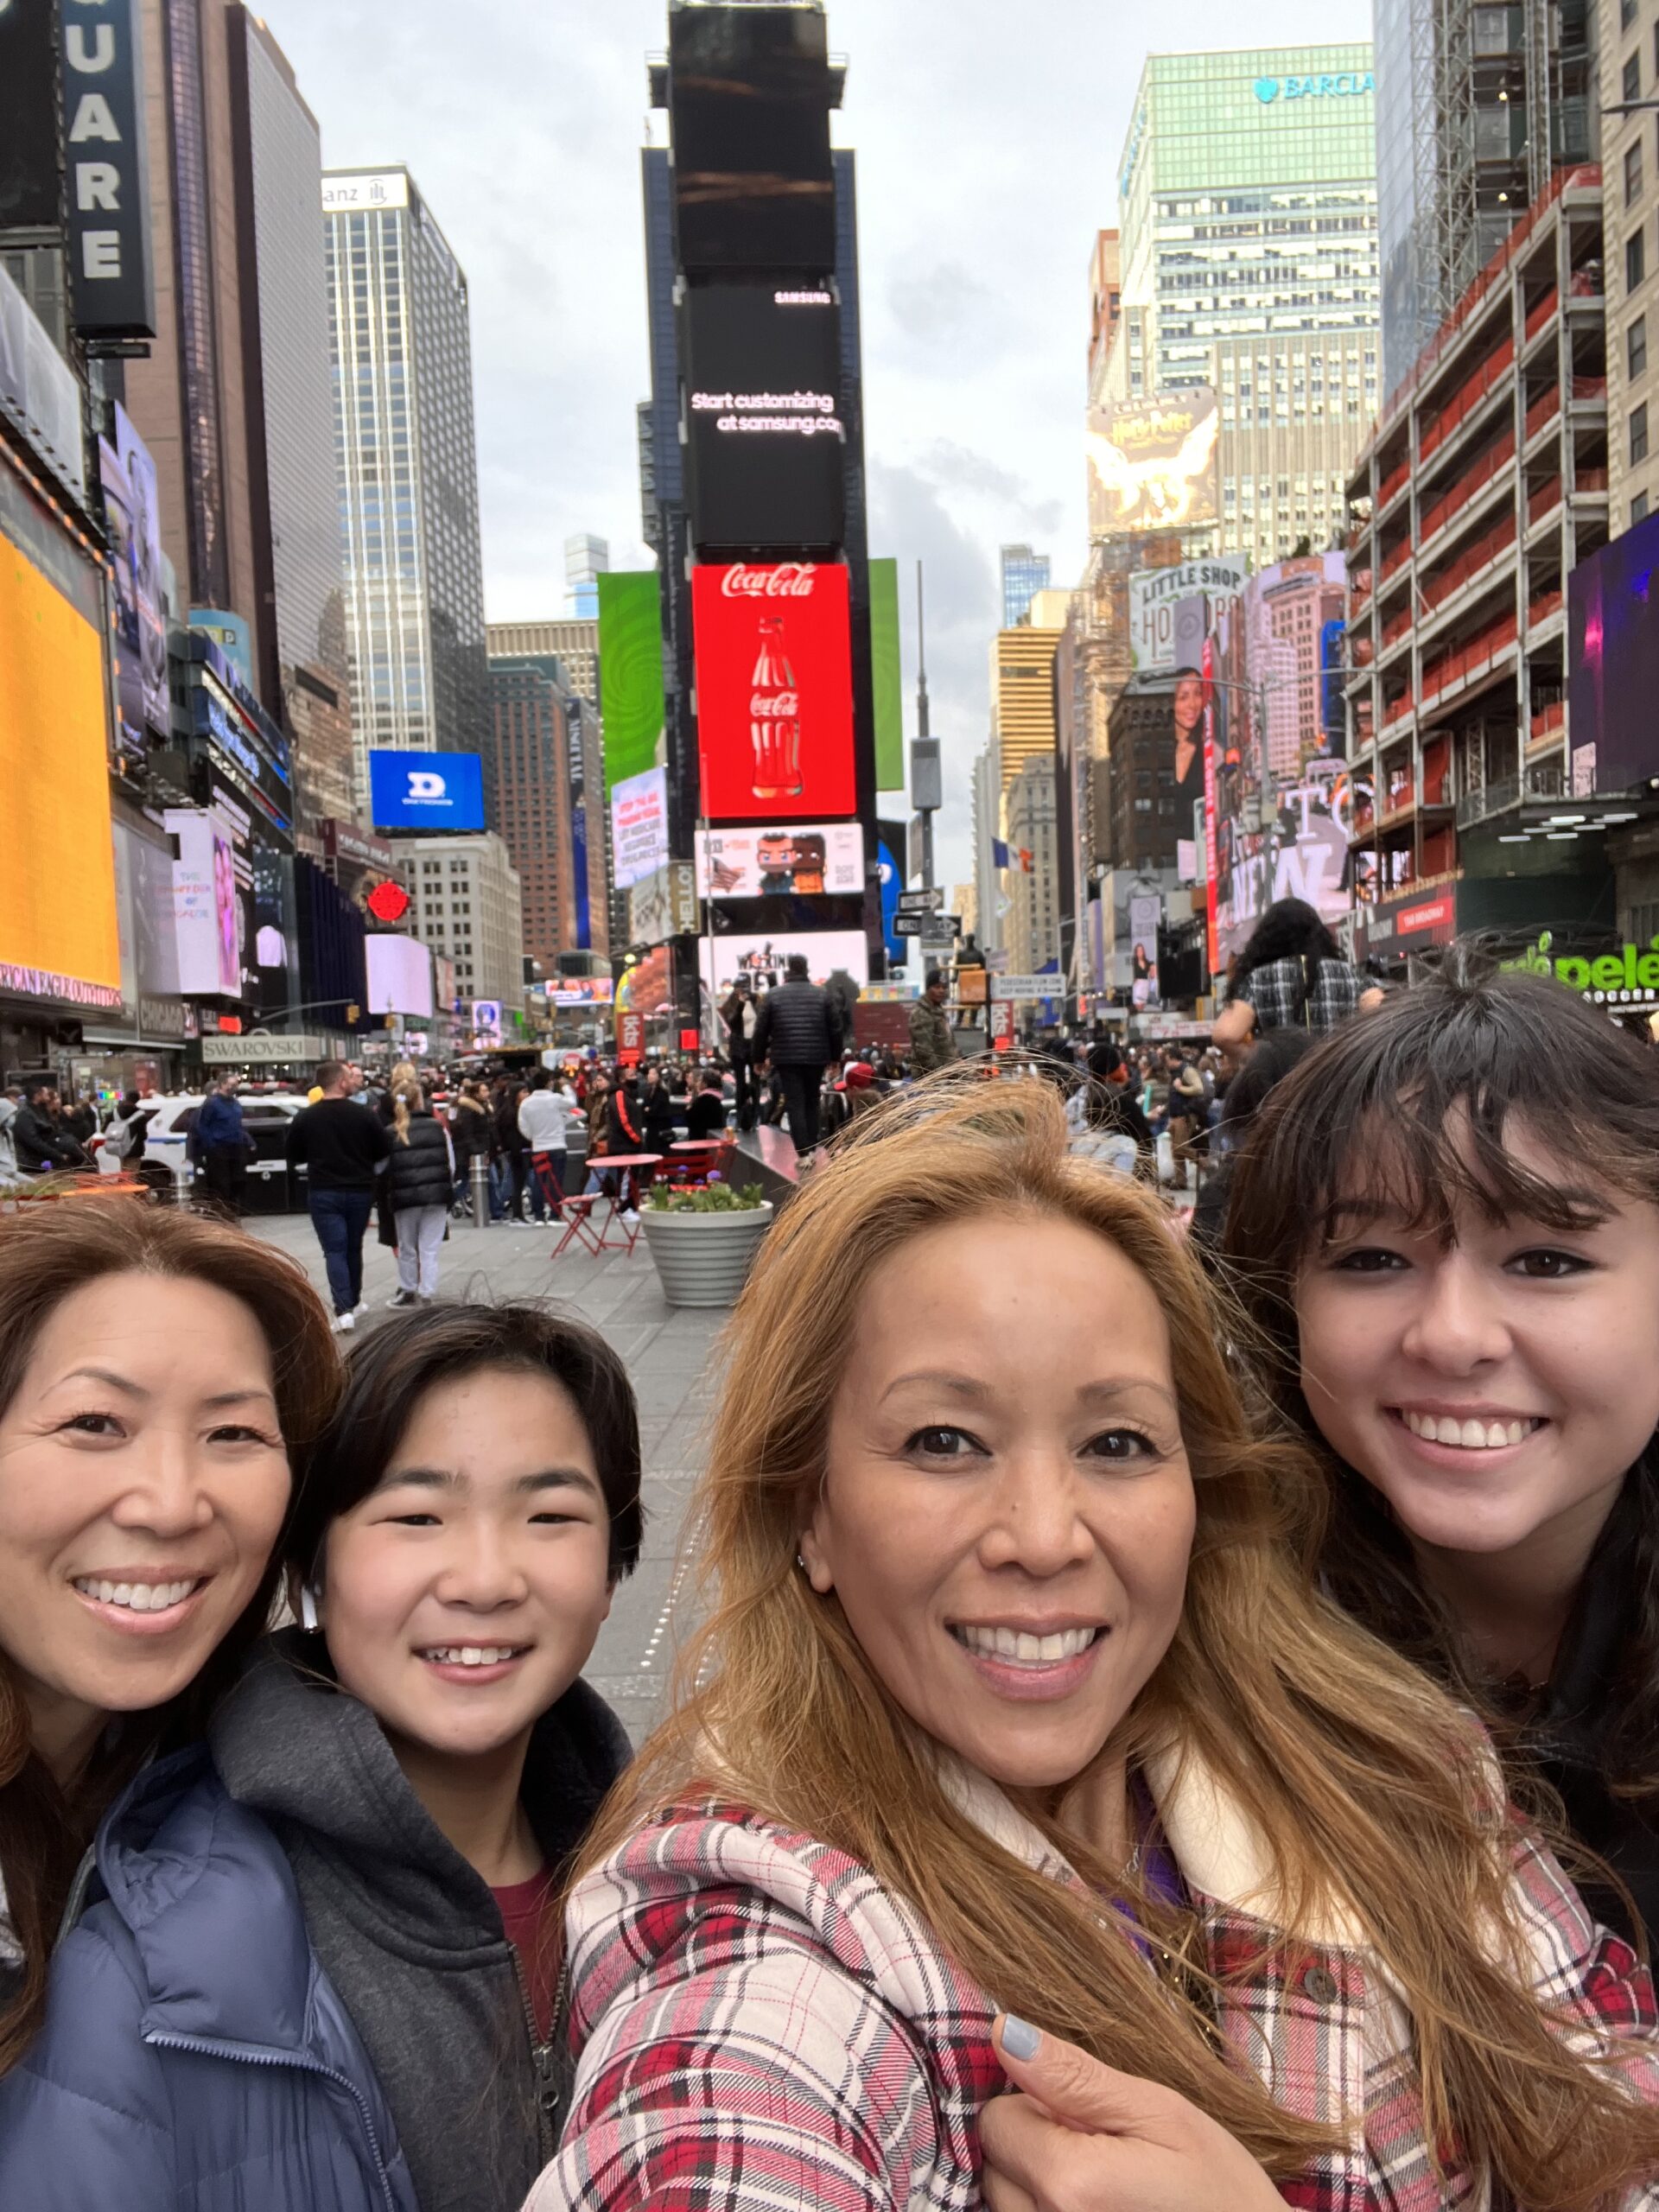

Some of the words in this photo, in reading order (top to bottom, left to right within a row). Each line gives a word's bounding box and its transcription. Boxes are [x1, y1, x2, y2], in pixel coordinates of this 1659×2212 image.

[65, 0, 123, 278] UARE
[775, 292, 831, 303] SAMSUNG
[691, 392, 734, 409] Start
[734, 391, 834, 413] customizing
[716, 415, 737, 430] at
[721, 563, 818, 597] Coca-Cola
[1142, 567, 1196, 606] LITTLE
[1200, 566, 1241, 590] SHOP
[749, 692, 799, 717] Coca-Cola
[623, 1015, 639, 1047] tkts
[204, 1040, 302, 1058] SWAROVSKI
